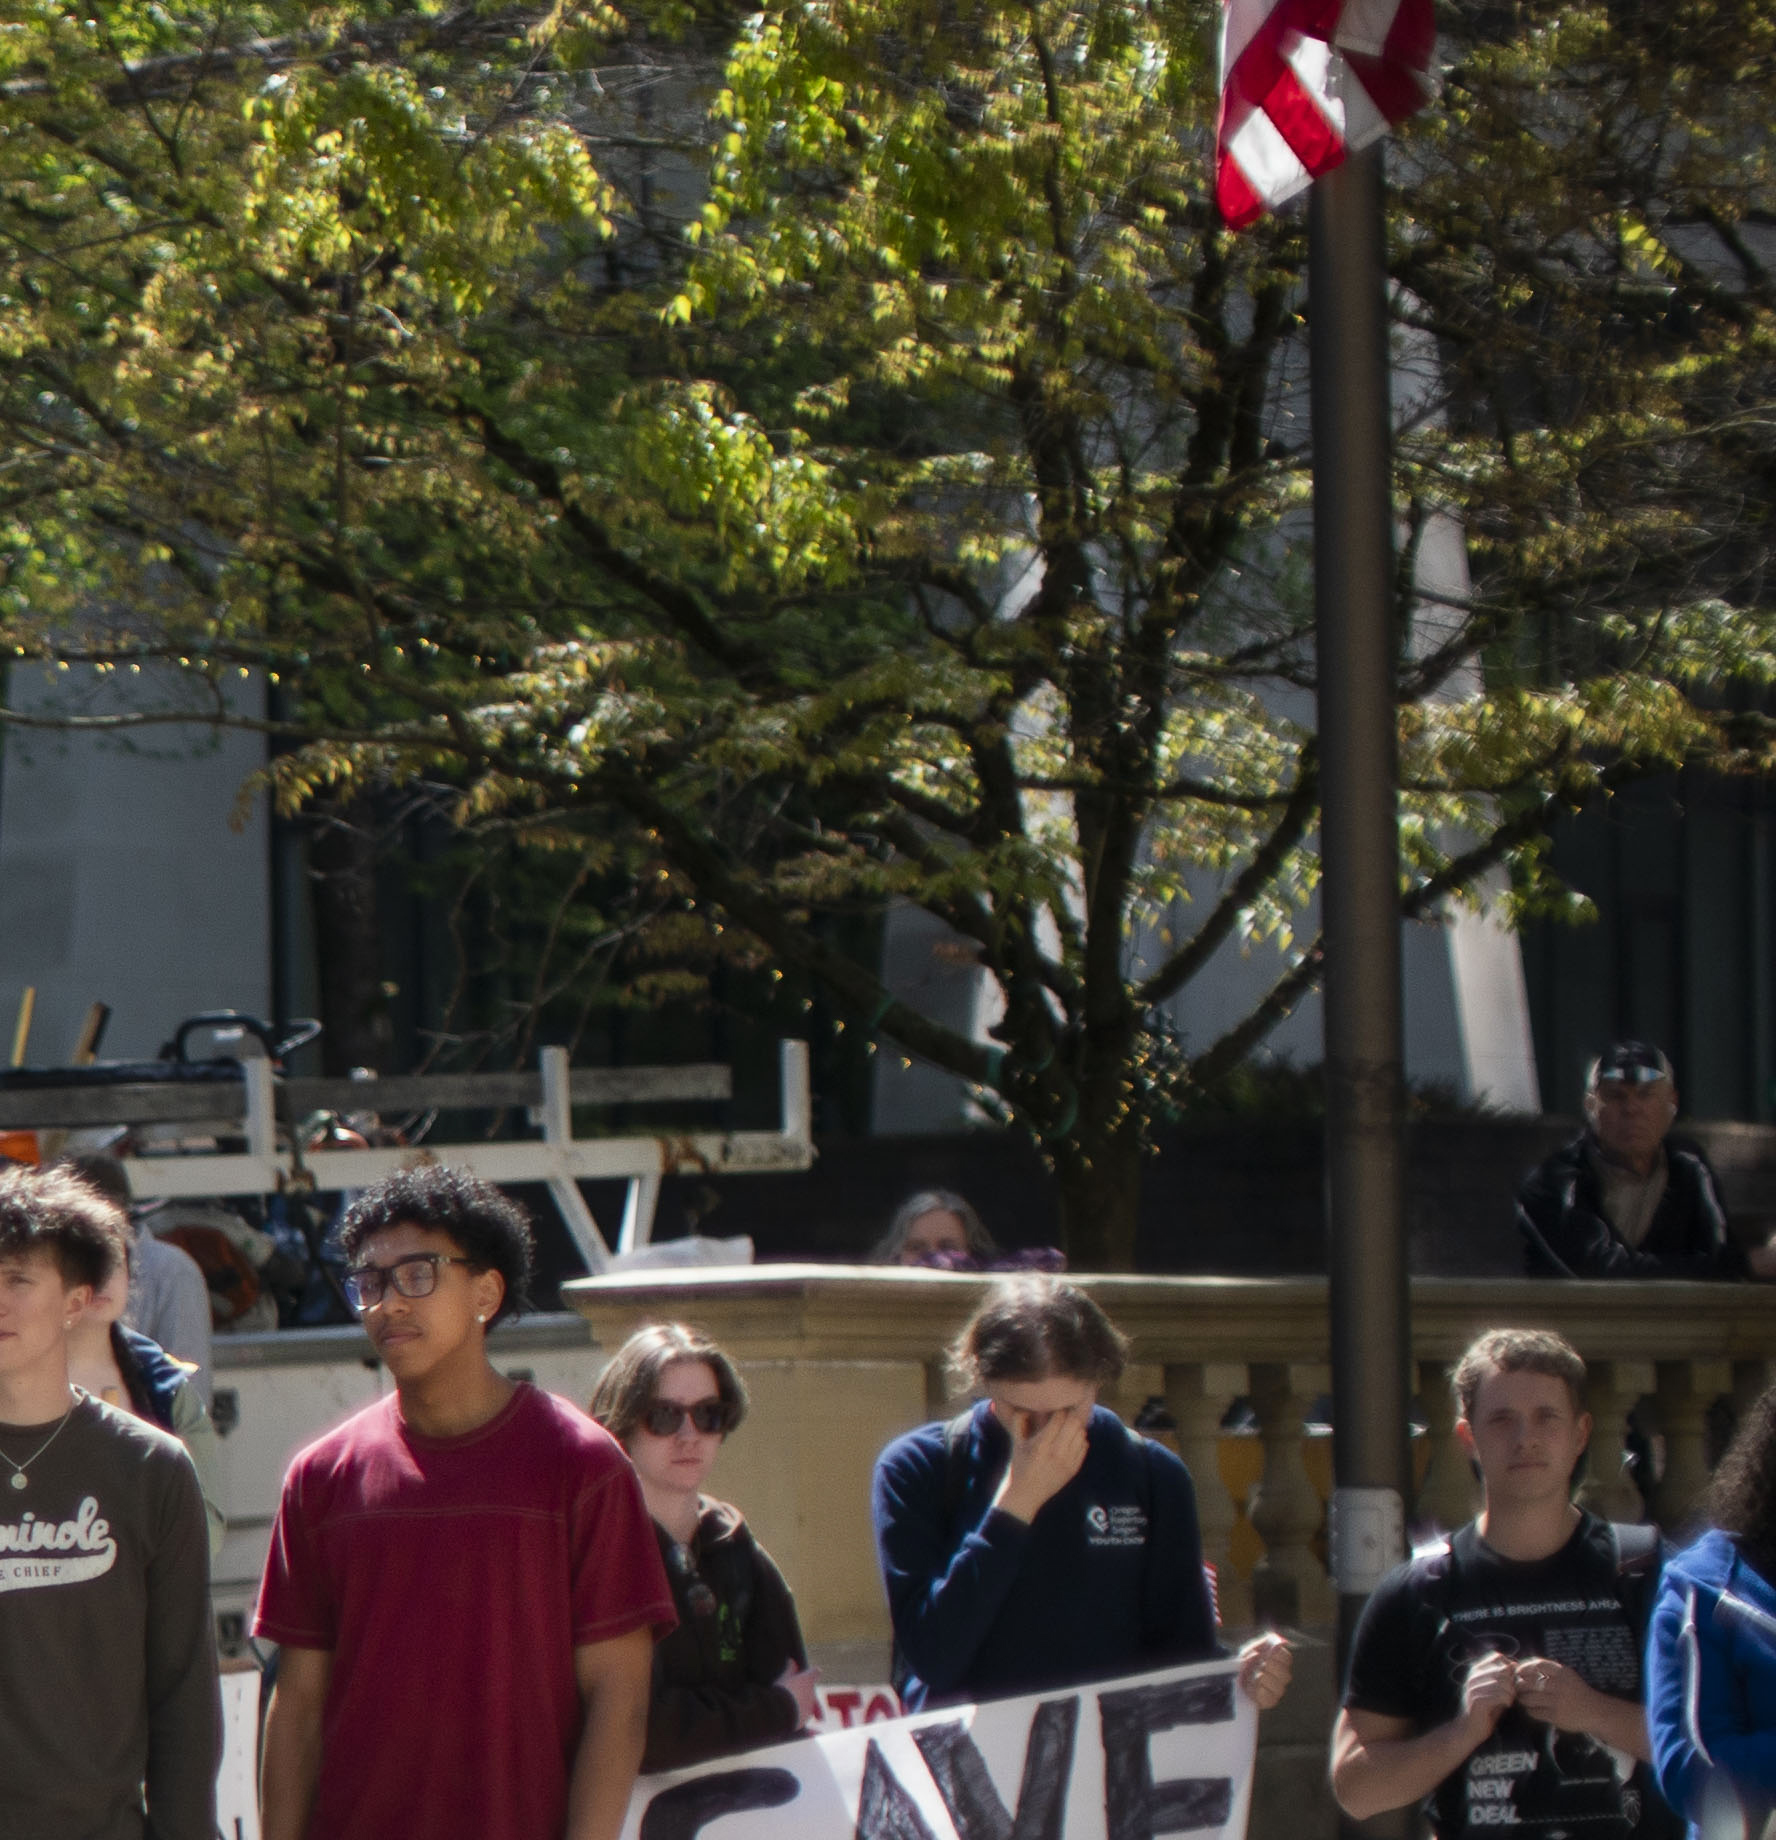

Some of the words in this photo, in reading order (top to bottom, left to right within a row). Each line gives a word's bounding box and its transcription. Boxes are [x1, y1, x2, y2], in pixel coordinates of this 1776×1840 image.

[13, 1565, 63, 1579] CHIEF
[1452, 1608, 1489, 1623] THERE
[1491, 1607, 1505, 1618] IS
[1508, 1599, 1587, 1617] BRIGHTNESS
[1588, 1597, 1622, 1610] AHEA
[1470, 1751, 1539, 1776] GREEN
[1467, 1778, 1516, 1799] NEW
[1470, 1804, 1522, 1825] DEAL
